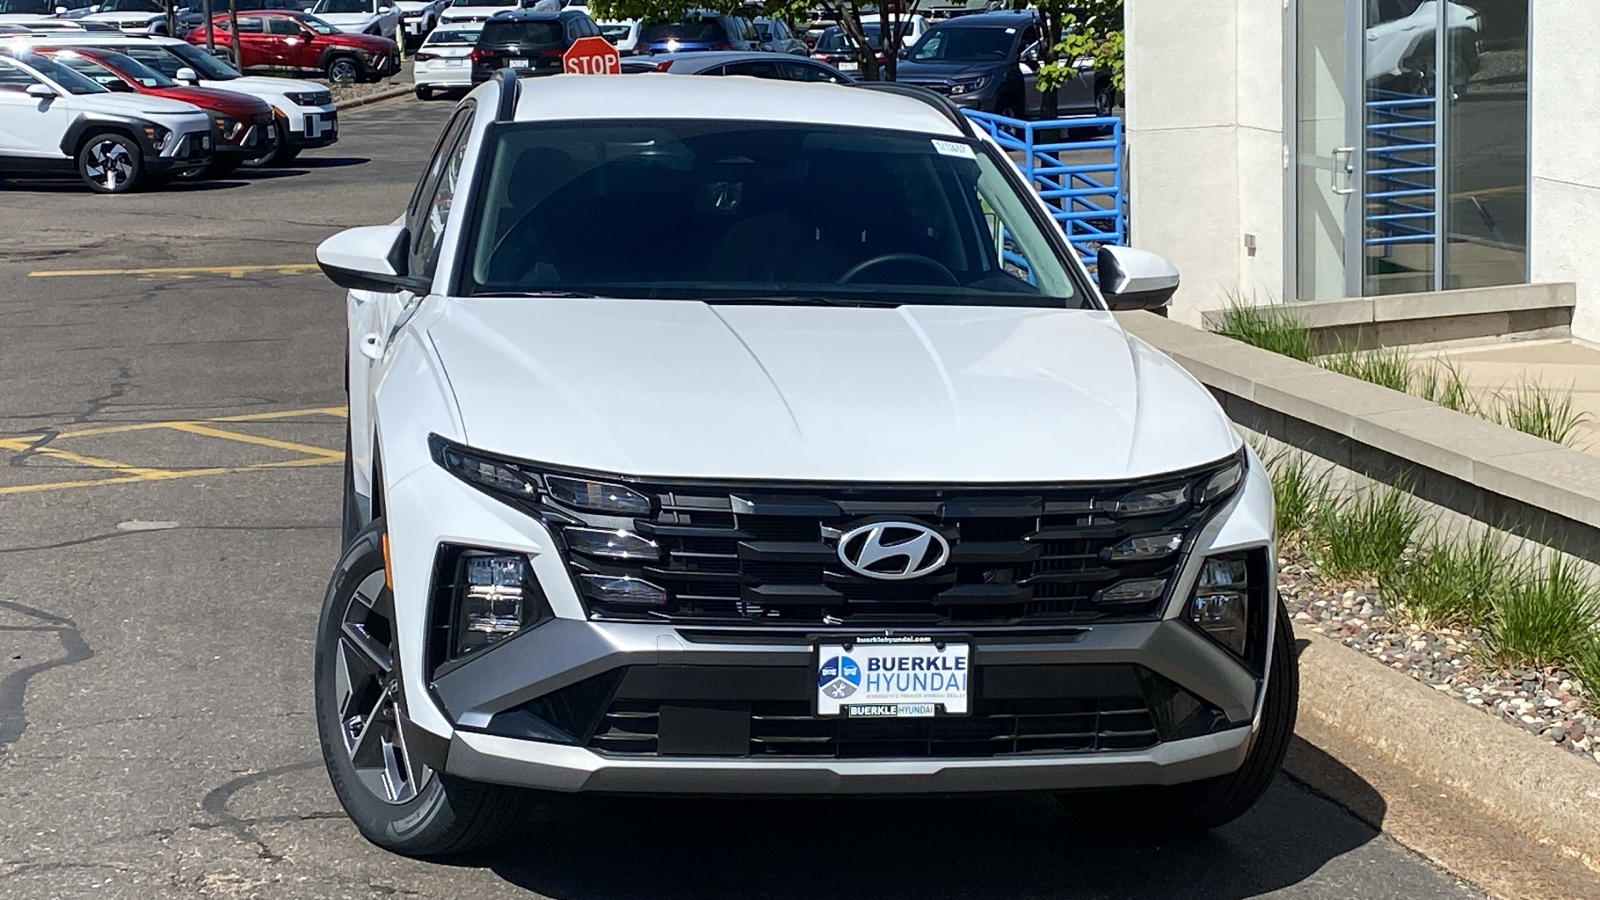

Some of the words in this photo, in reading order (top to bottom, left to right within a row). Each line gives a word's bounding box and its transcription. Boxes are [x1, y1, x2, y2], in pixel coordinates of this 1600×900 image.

[568, 54, 617, 75] STOP
[857, 636, 931, 644] buerklehyundai.com
[868, 656, 966, 671] BUERKLE
[867, 673, 967, 692] HYUNDAI
[851, 705, 897, 715] BUERKLE
[898, 705, 933, 715] HYUNDAI
